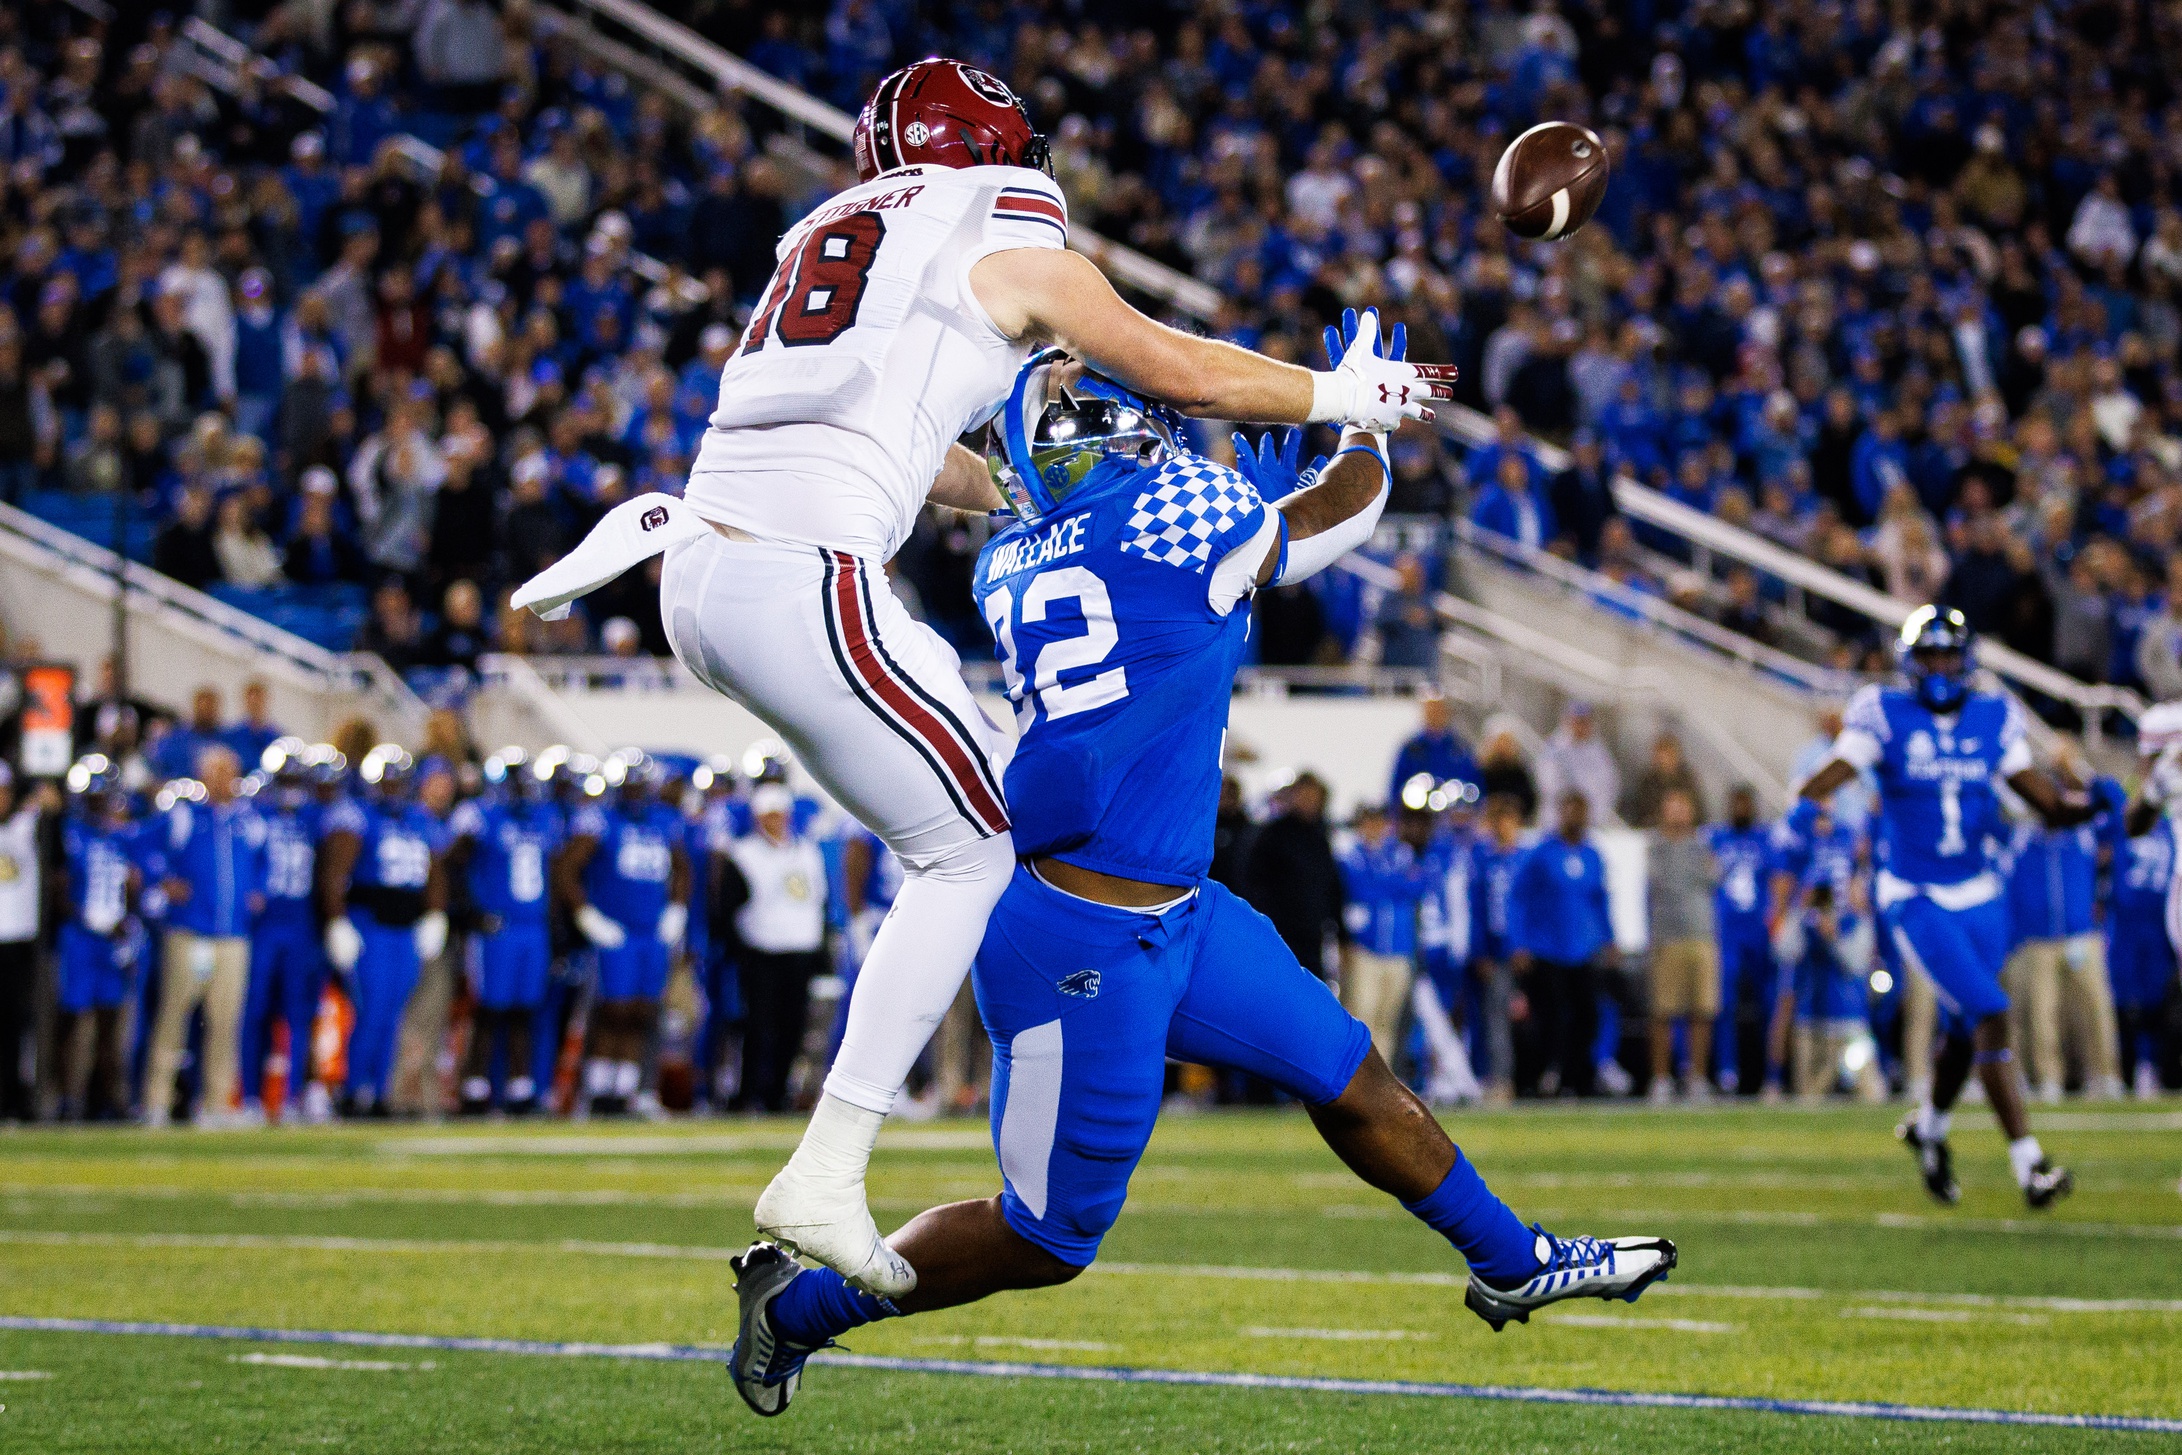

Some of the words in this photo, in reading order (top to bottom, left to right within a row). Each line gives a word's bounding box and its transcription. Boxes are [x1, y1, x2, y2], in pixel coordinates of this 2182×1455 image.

[906, 123, 930, 145] SEC
[798, 185, 925, 233] STOGNER
[741, 210, 887, 357] 18
[987, 512, 1092, 584] WALLACE
[1937, 776, 1967, 857] 1
